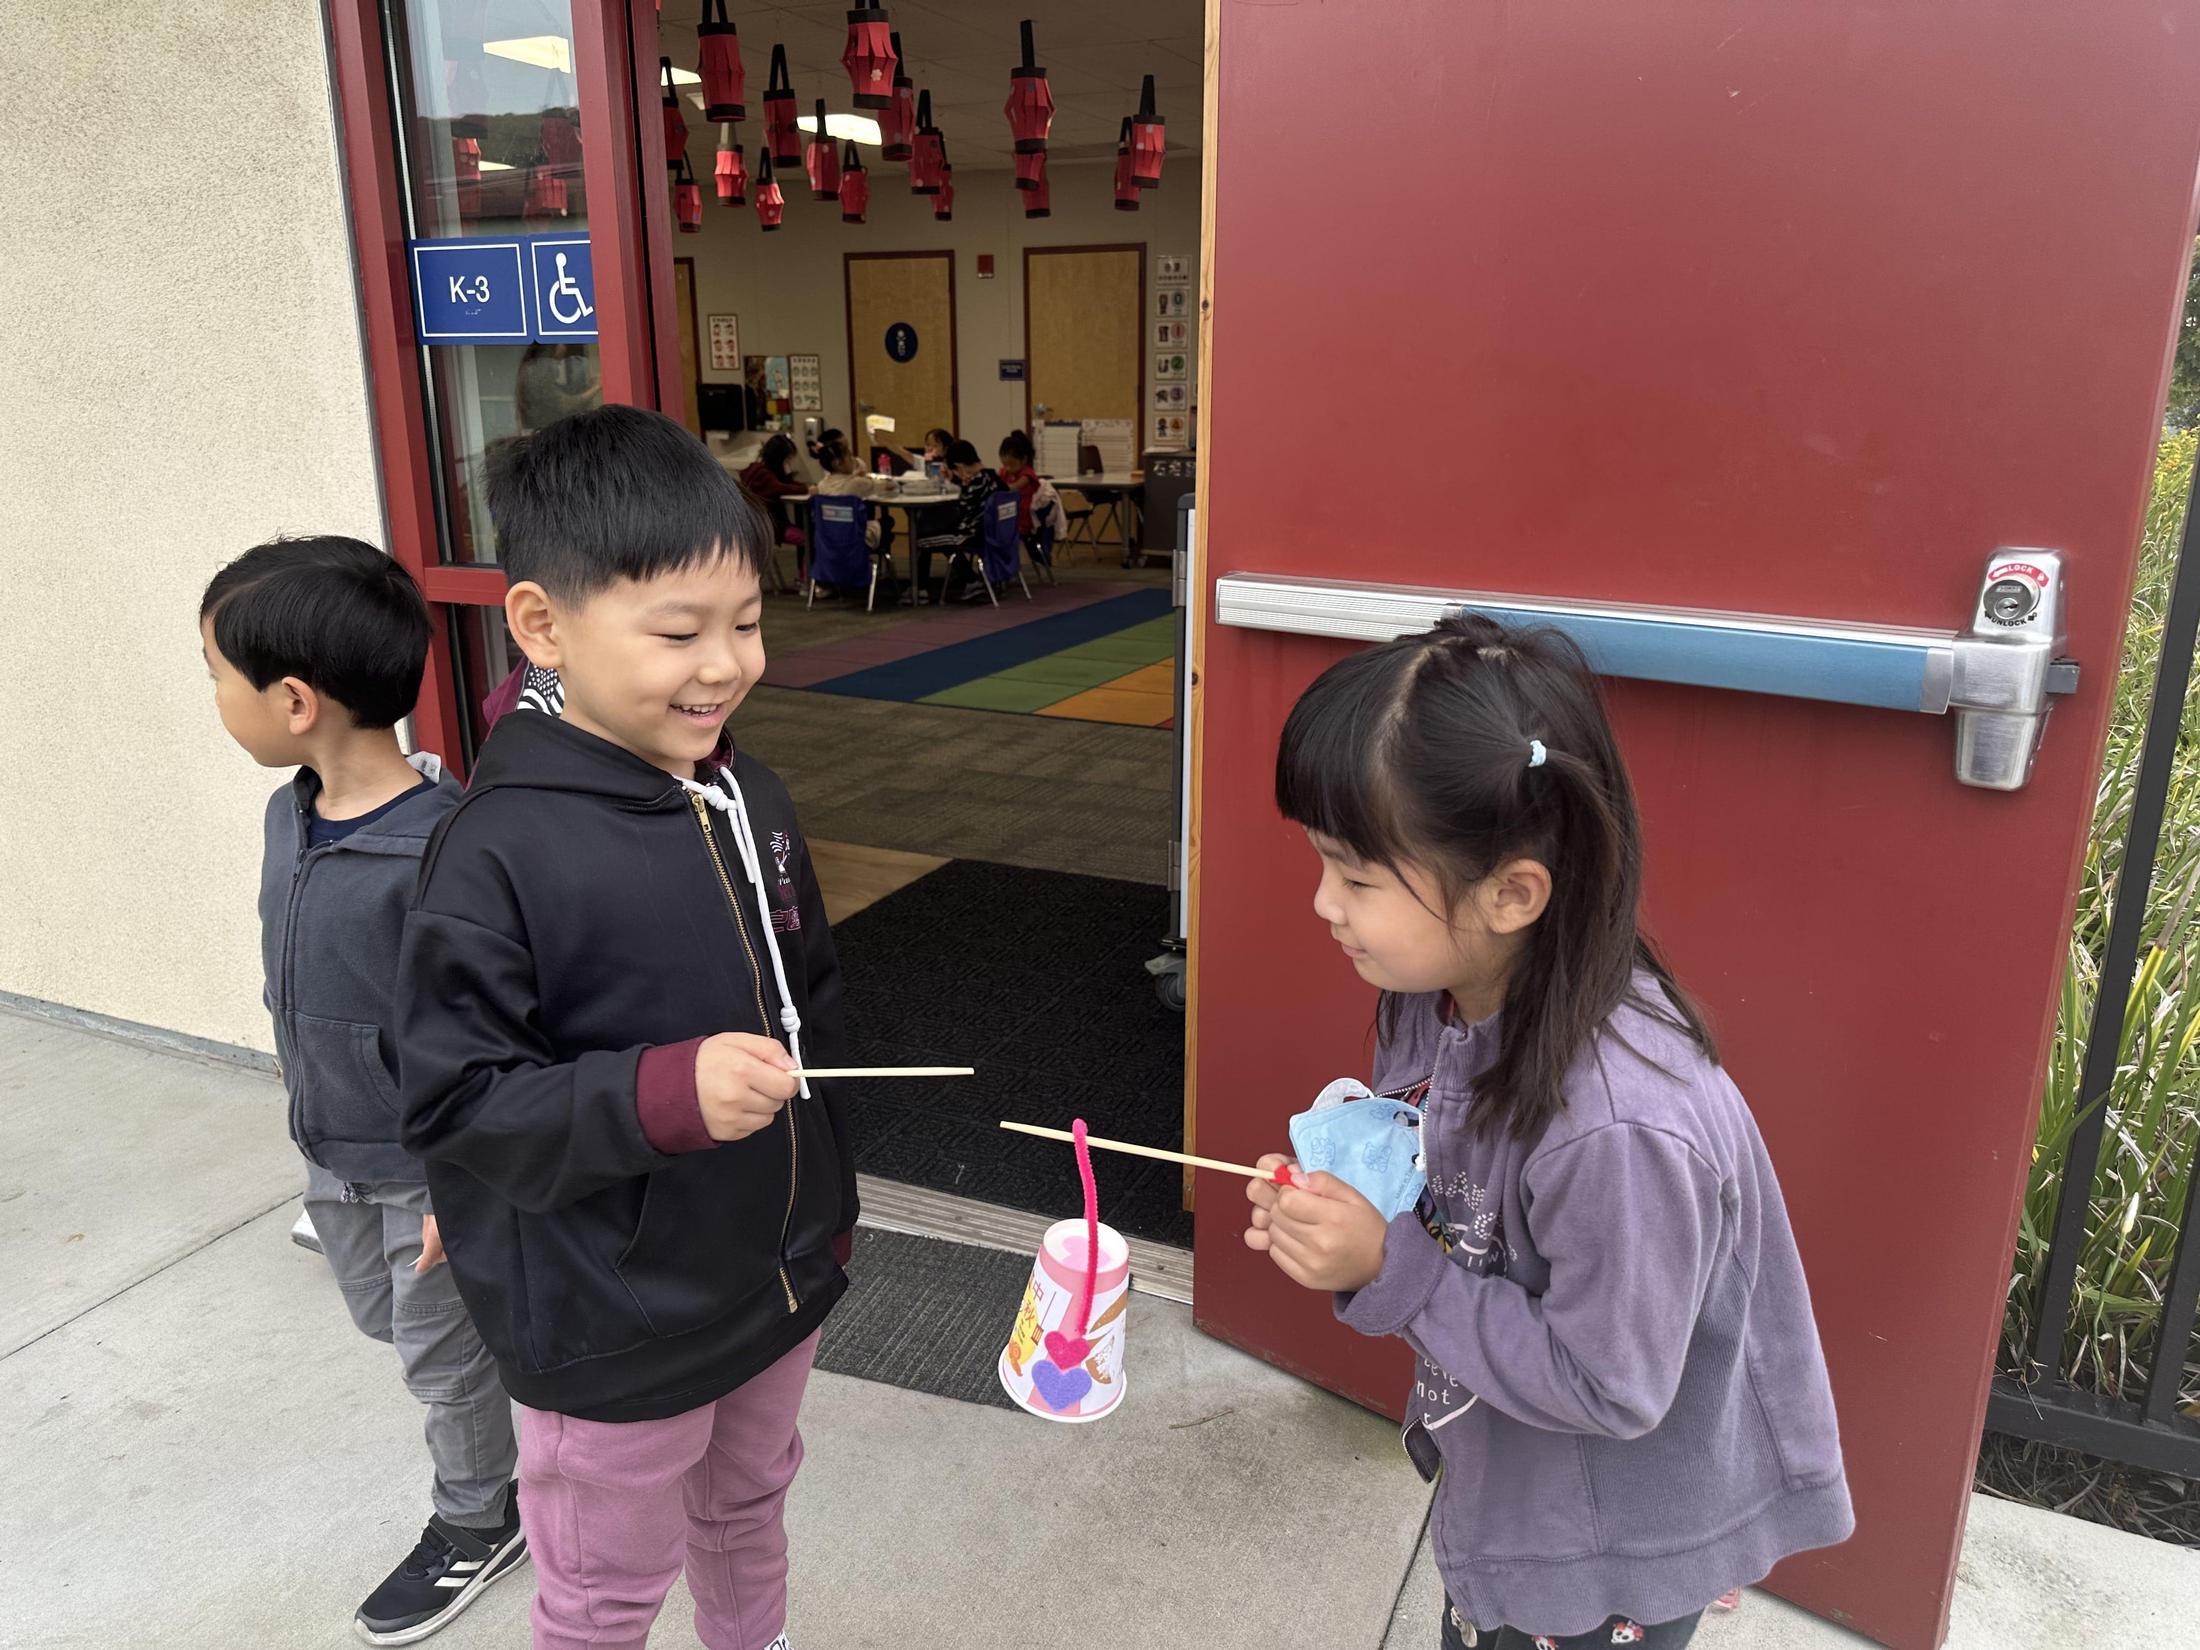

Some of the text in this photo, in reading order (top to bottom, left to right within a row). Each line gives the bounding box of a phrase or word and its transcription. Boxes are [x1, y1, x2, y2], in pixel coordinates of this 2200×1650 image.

[449, 275, 490, 303] K-3
[2008, 564, 2034, 573] LOCK
[1991, 618, 2027, 627] UNLOCK
[1416, 1380, 1450, 1405] not
